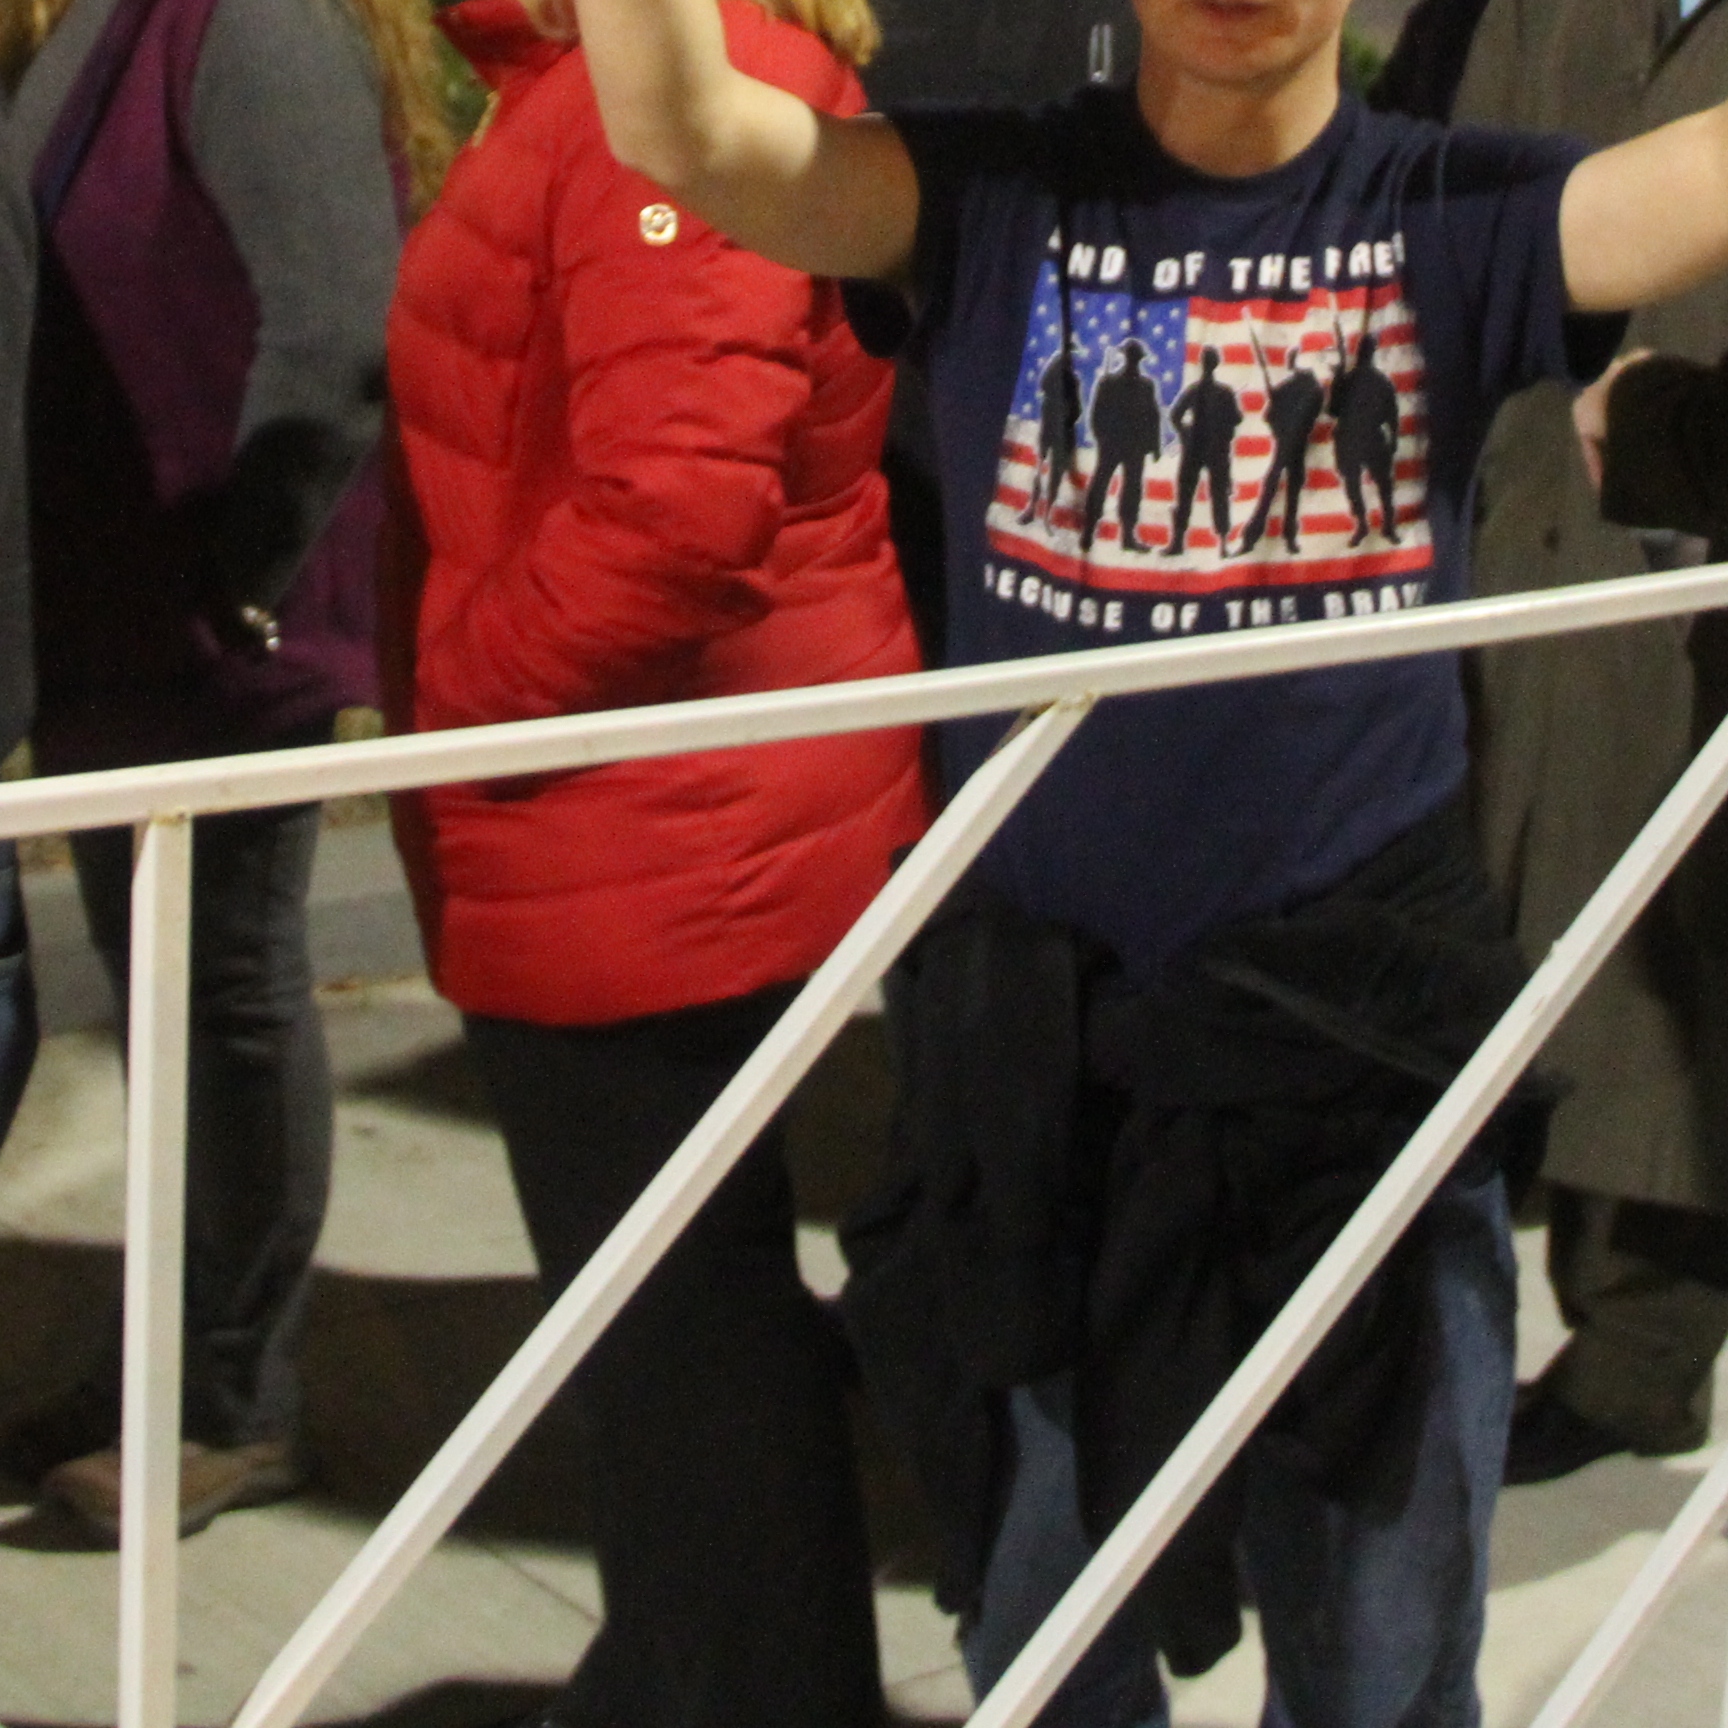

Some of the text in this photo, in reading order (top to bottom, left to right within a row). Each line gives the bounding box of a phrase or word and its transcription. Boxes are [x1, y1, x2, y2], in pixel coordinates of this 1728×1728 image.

[1152, 251, 1205, 291] OF
[1228, 253, 1312, 293] THE
[1150, 601, 1202, 632] OF
[1225, 595, 1300, 629] THE
